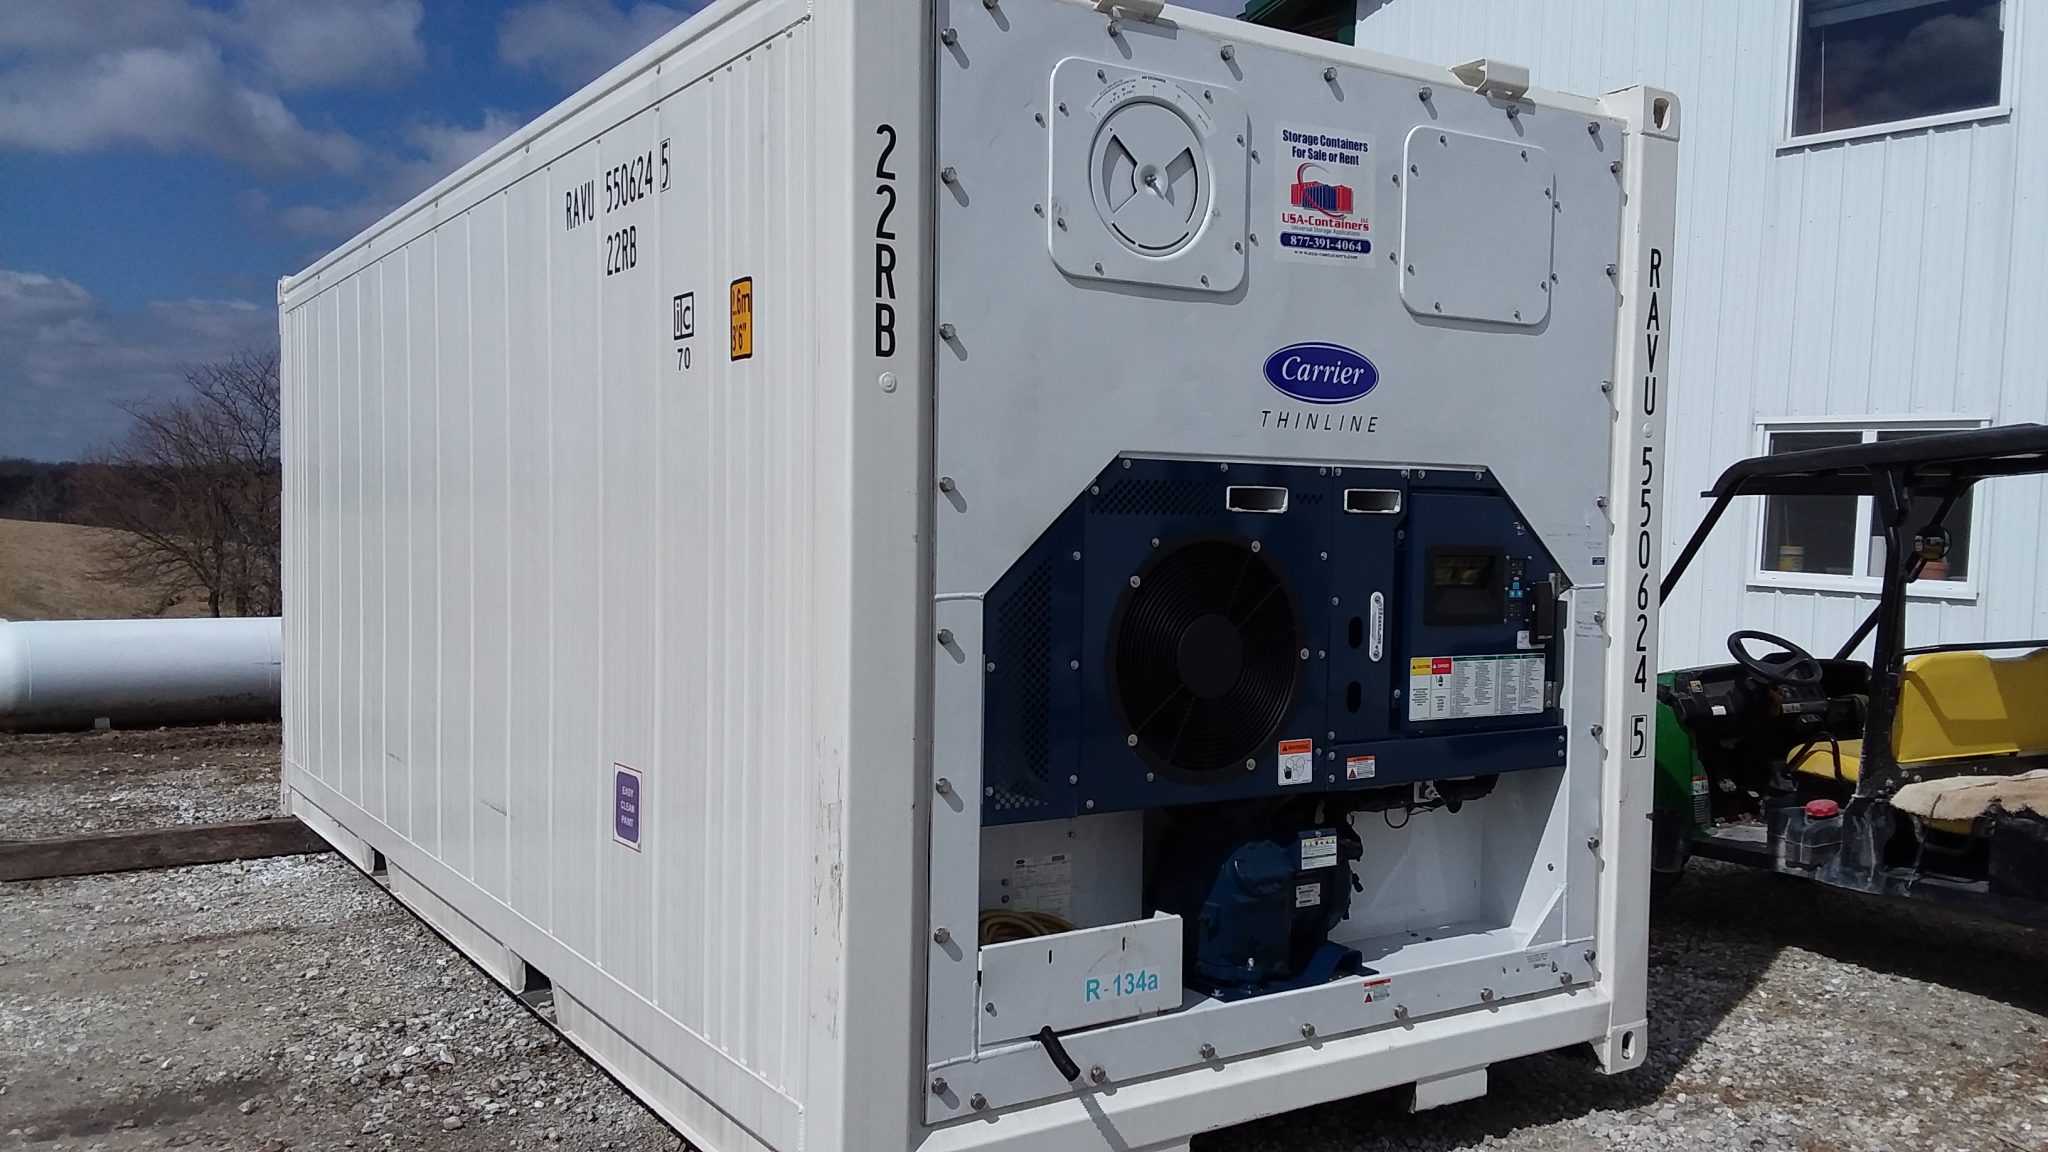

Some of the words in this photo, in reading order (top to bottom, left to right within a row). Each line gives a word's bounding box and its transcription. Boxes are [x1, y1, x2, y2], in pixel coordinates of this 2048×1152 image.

[1282, 129, 1319, 146] Storage
[1320, 135, 1368, 153] Containers
[1292, 146, 1306, 159] For
[1308, 148, 1327, 161] Sale
[1329, 152, 1338, 163] or
[1339, 152, 1359, 166] Rent
[565, 180, 595, 231] RAVU
[606, 150, 653, 214] 550624
[661, 141, 669, 190] 5
[1282, 212, 1370, 232] USA-Containers
[1314, 226, 1332, 235] Storage
[606, 225, 637, 276] 22RB
[875, 124, 897, 358] 22RB
[1290, 235, 1362, 252] 877-391-4064
[1644, 248, 1662, 416] RAVU
[677, 346, 691, 371] 70
[1281, 356, 1365, 385] Carrier
[1261, 410, 1379, 433] THINLINE
[1634, 446, 1653, 694] 550624
[1632, 716, 1646, 757] 5
[622, 786, 634, 797] EASY
[621, 801, 634, 813] CLEAN
[621, 816, 633, 827] PAINT
[1086, 970, 1158, 1002] R-134a
